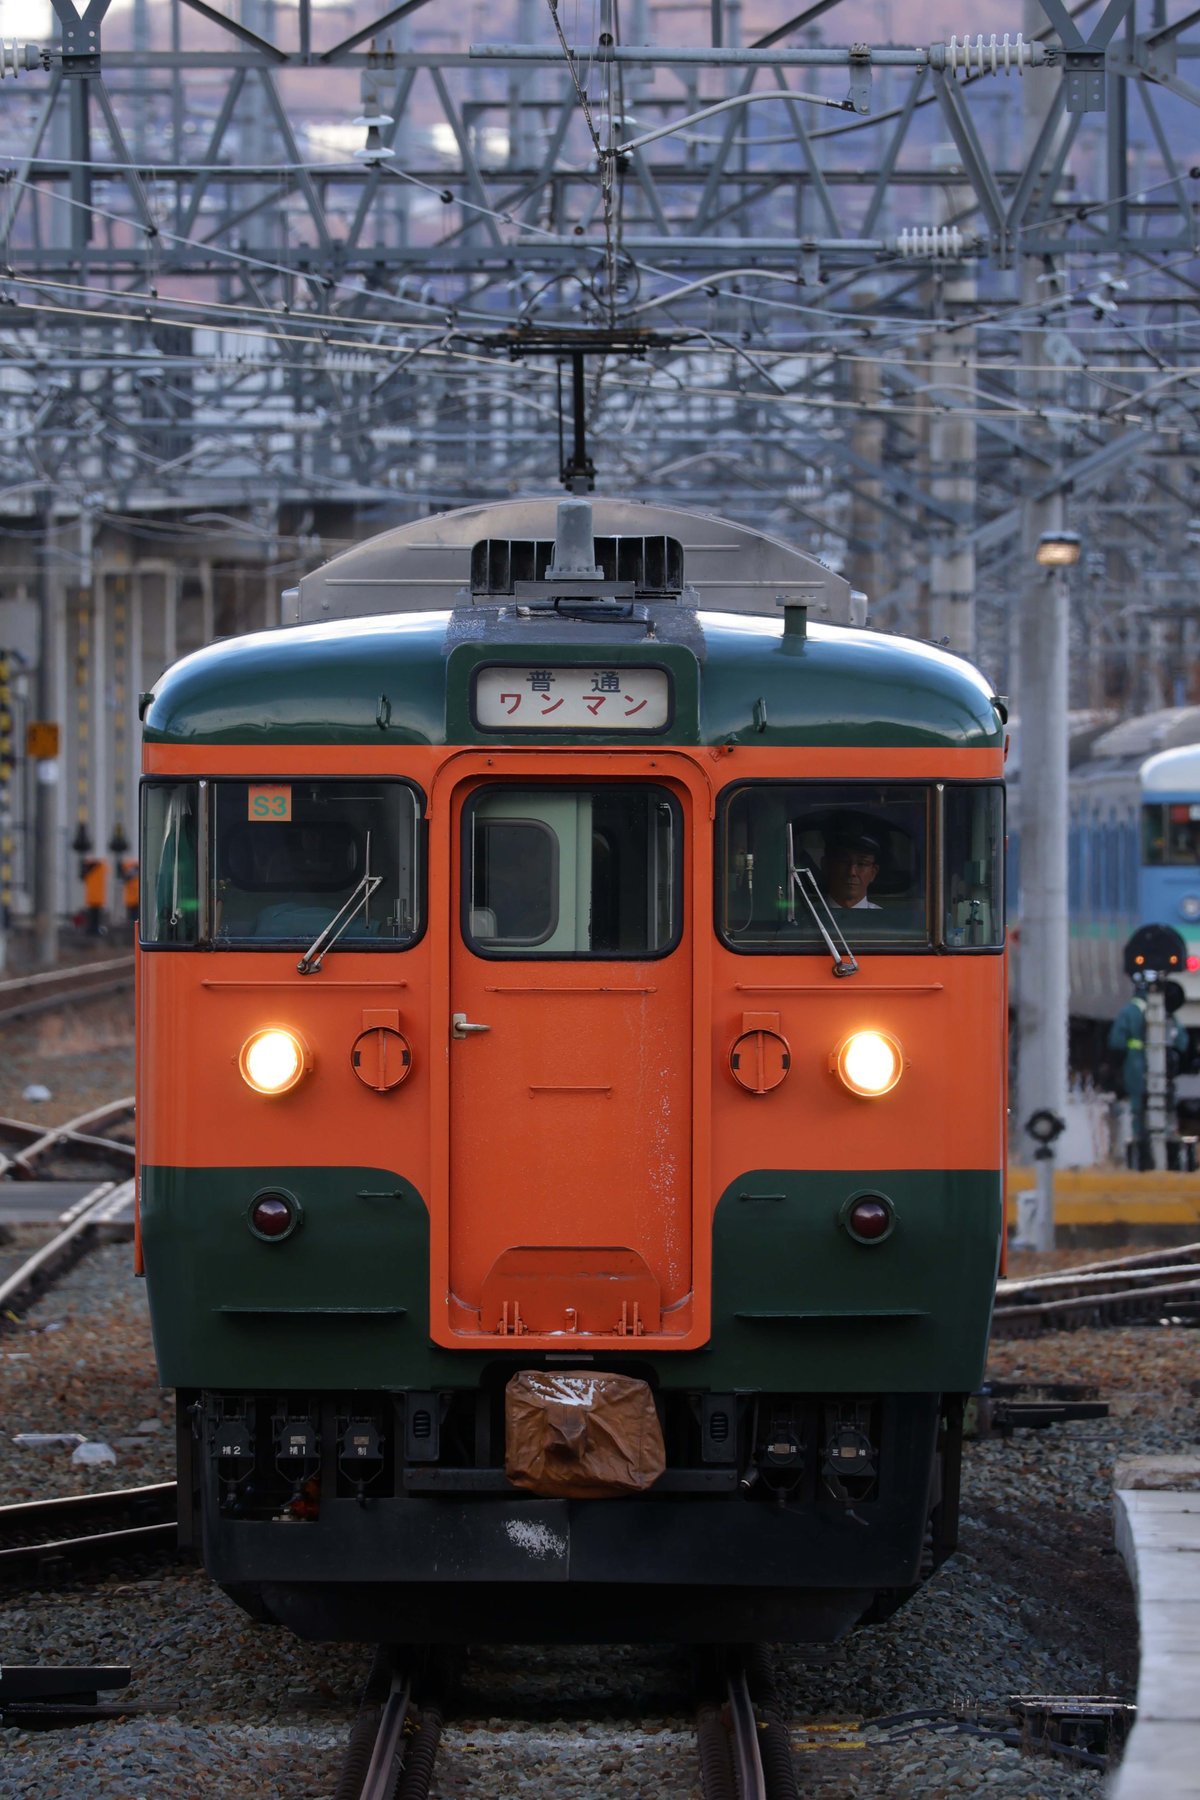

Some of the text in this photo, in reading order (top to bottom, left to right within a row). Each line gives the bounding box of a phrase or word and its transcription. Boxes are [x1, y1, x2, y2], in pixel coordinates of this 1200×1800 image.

[526, 670, 621, 693] 普通
[500, 693, 648, 716] ワンマン
[253, 795, 287, 817] S3
